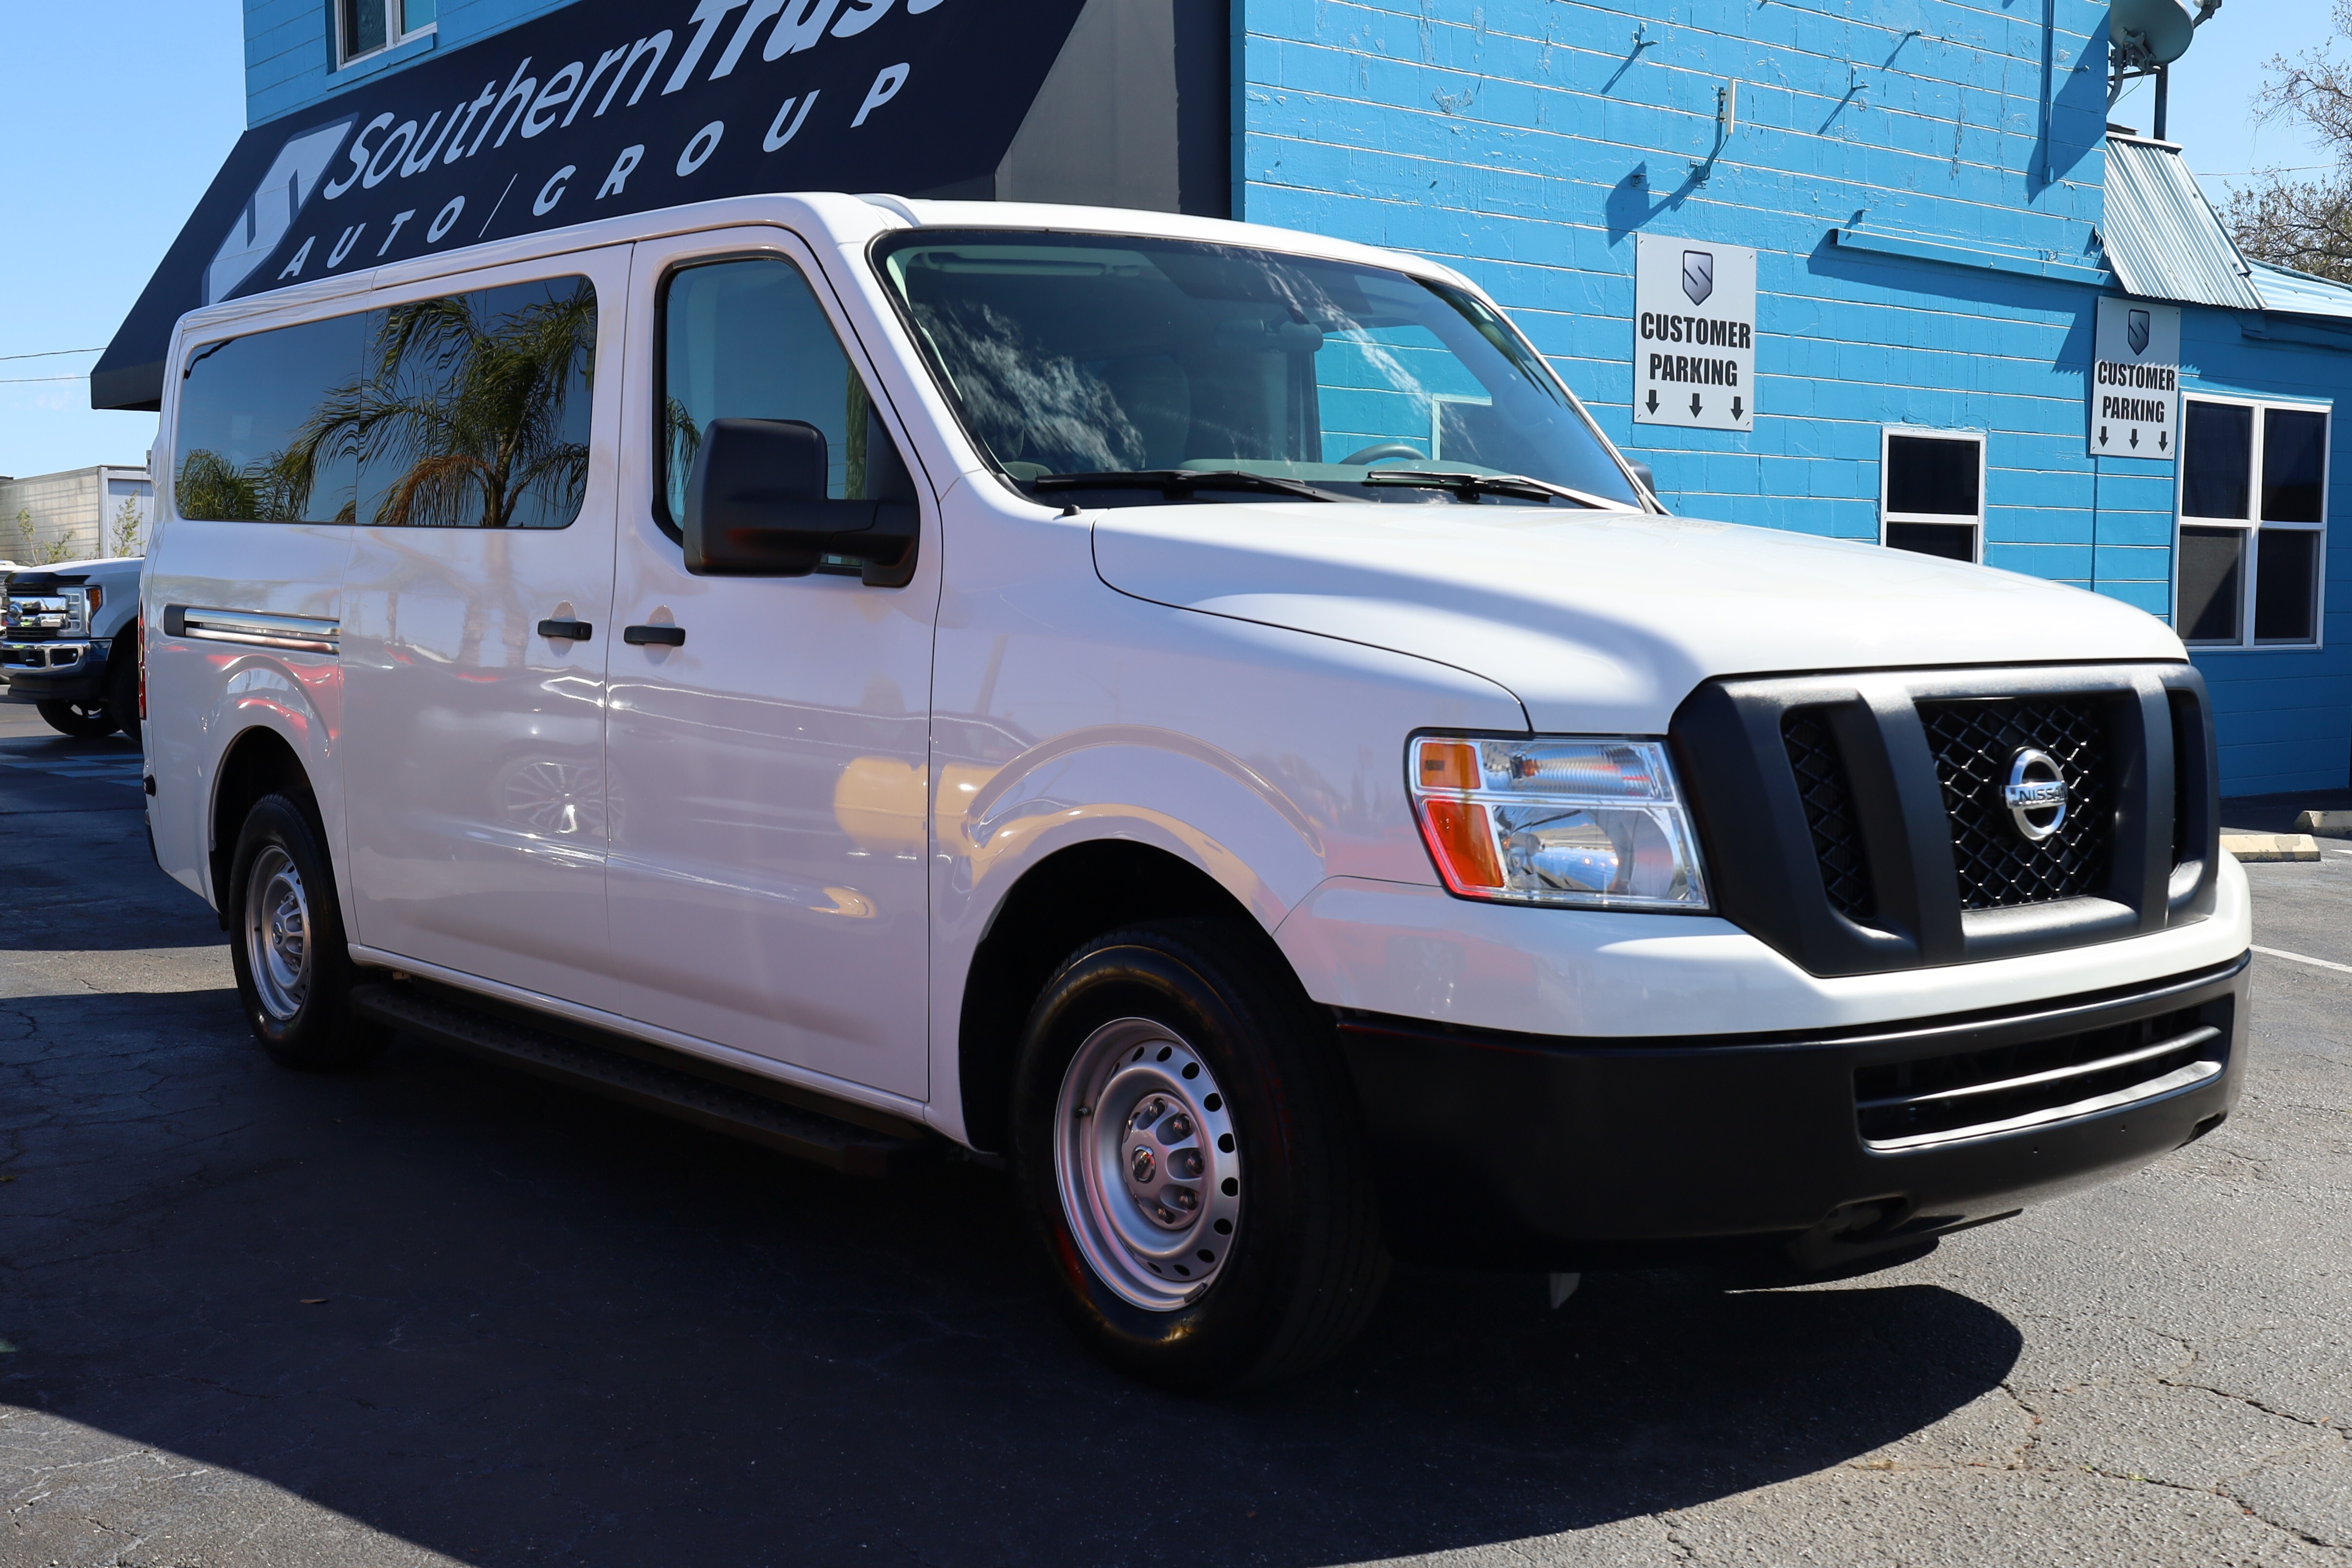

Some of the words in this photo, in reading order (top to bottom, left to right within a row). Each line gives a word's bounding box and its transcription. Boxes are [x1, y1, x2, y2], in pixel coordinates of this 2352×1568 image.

[323, 0, 945, 200] SouthernTru
[277, 195, 465, 280] AUTO
[533, 62, 910, 216] GROUP
[1640, 312, 1751, 349] CUSTOMER
[1649, 353, 1737, 387] PARKING
[2098, 361, 2175, 391] CUSTOMER
[2102, 395, 2165, 424] PARKING
[2019, 786, 2068, 802] NISSAN
